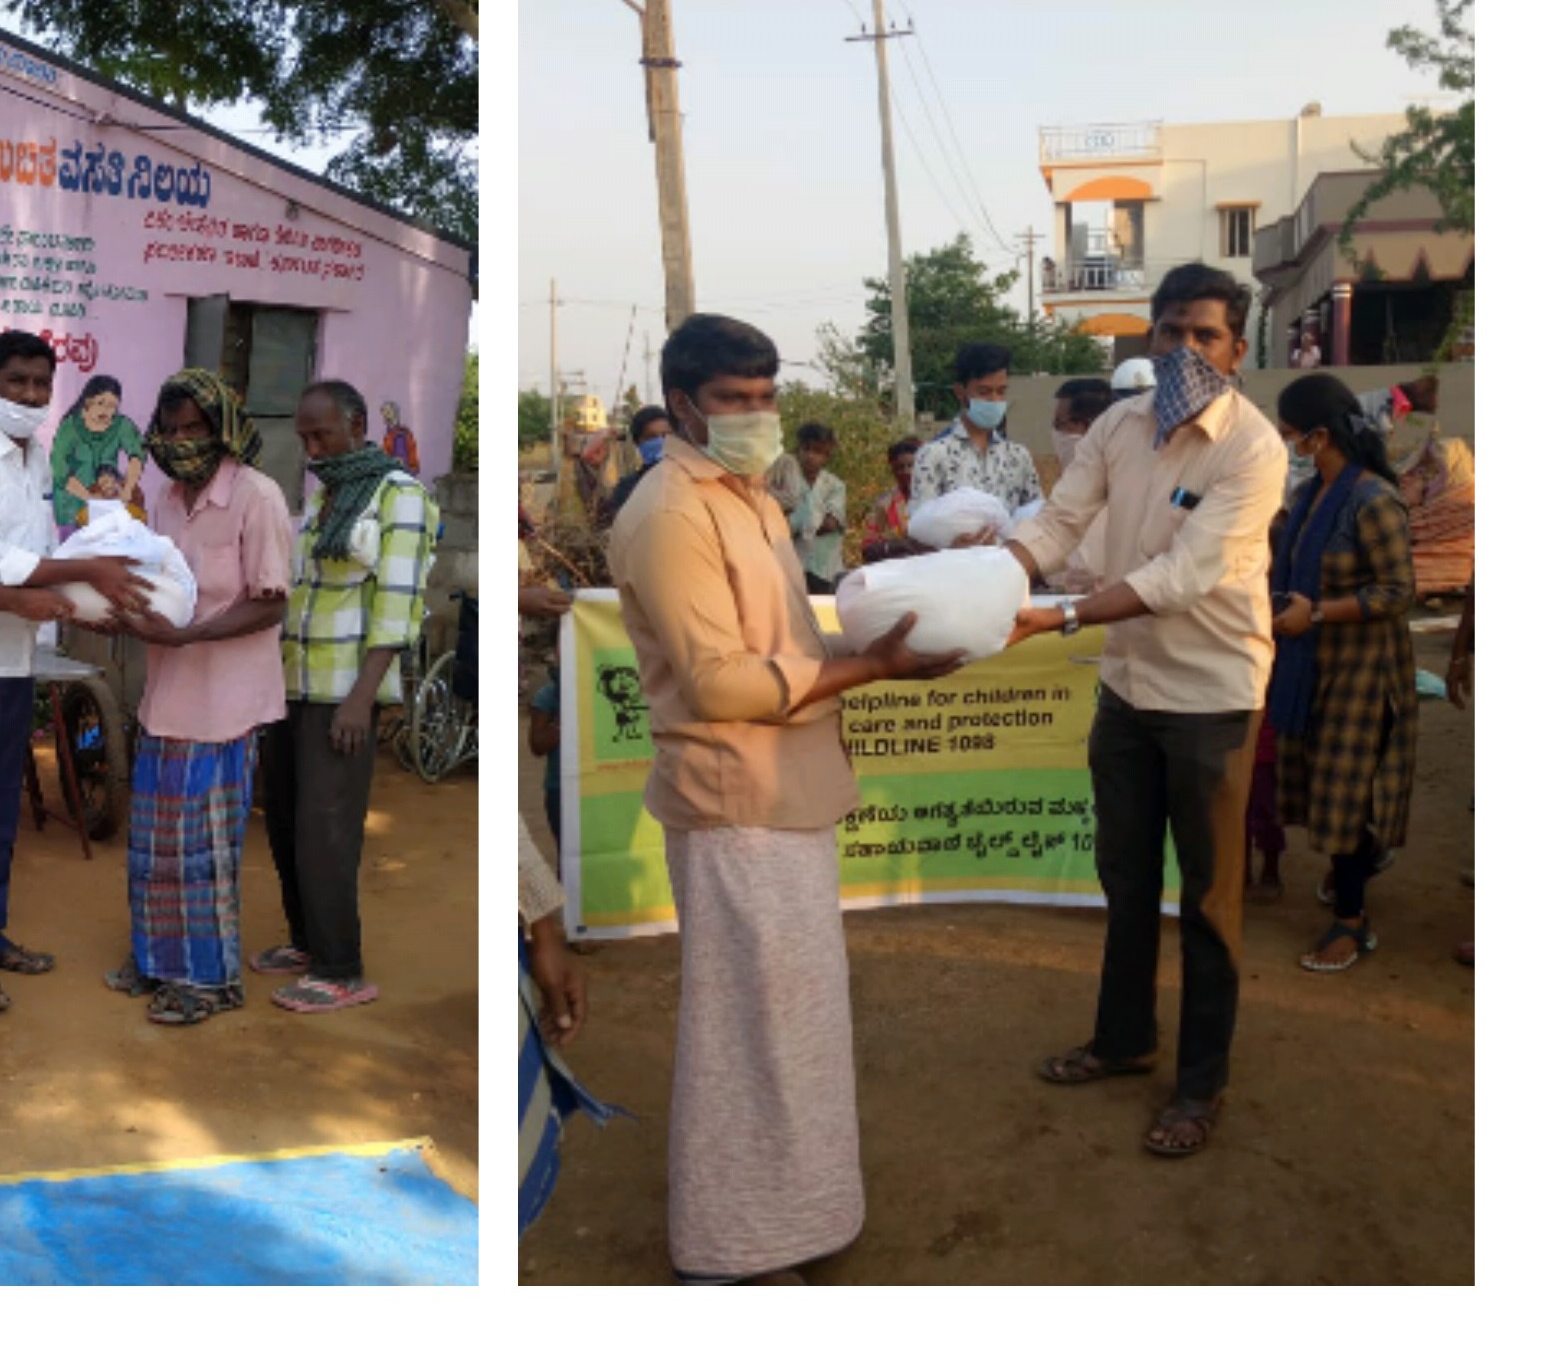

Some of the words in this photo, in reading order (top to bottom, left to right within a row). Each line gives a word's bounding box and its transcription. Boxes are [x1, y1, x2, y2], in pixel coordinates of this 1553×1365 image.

[928, 688, 958, 706] for
[963, 686, 1047, 706] children
[849, 718, 895, 734] care
[903, 714, 941, 732] and
[947, 709, 1054, 733] protection
[949, 733, 995, 753] 1098
